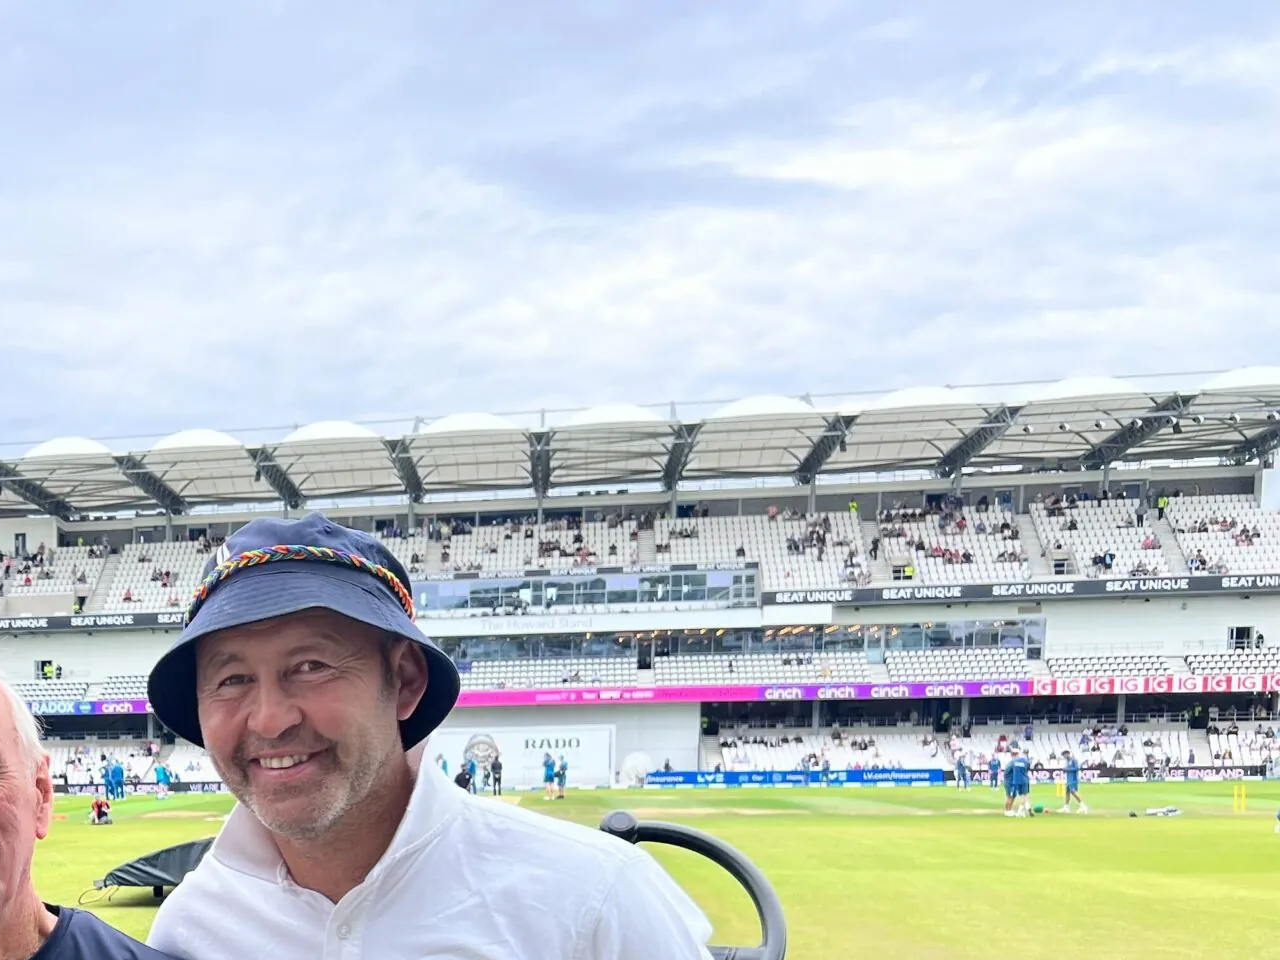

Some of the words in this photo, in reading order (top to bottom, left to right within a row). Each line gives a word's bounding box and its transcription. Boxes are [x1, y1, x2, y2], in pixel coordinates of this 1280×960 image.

[1105, 580, 1138, 591] SEAT
[1140, 579, 1189, 591] UNIQUE
[1222, 577, 1255, 588] SEAT
[1257, 575, 1280, 586] UNI
[882, 588, 914, 600] SEAT
[915, 586, 962, 599] UNIQUE
[992, 585, 1025, 596] SEAT
[1026, 583, 1074, 595] UNIQUE
[775, 592, 806, 603] SEAT
[807, 590, 853, 602] UNIQUE
[11, 618, 48, 628] UNIQUE
[70, 617, 96, 627] SEAT
[96, 615, 134, 626] UNIQUE
[158, 614, 183, 624] SEAT
[481, 619, 504, 630] The
[507, 617, 554, 630] Howard
[560, 617, 593, 629] Stand
[981, 682, 1020, 695] cinch
[1034, 680, 1052, 694] IG
[1062, 679, 1081, 692] IG
[1090, 678, 1112, 693] IG
[1119, 677, 1138, 691] IG
[1149, 677, 1169, 692] IG
[1178, 676, 1197, 690] IG
[1207, 676, 1228, 691] IG
[1237, 675, 1256, 689] IG
[765, 687, 801, 699] cinch
[817, 686, 855, 699] cinch
[871, 685, 909, 698] cinch
[925, 683, 963, 696] cinch
[31, 702, 75, 713] RADOX
[102, 702, 133, 713] cinch
[525, 737, 581, 749] RADO
[1053, 770, 1101, 779] CRKET
[1188, 769, 1245, 778] ENGLAND
[190, 784, 202, 792] WE
[203, 784, 218, 792] ARE
